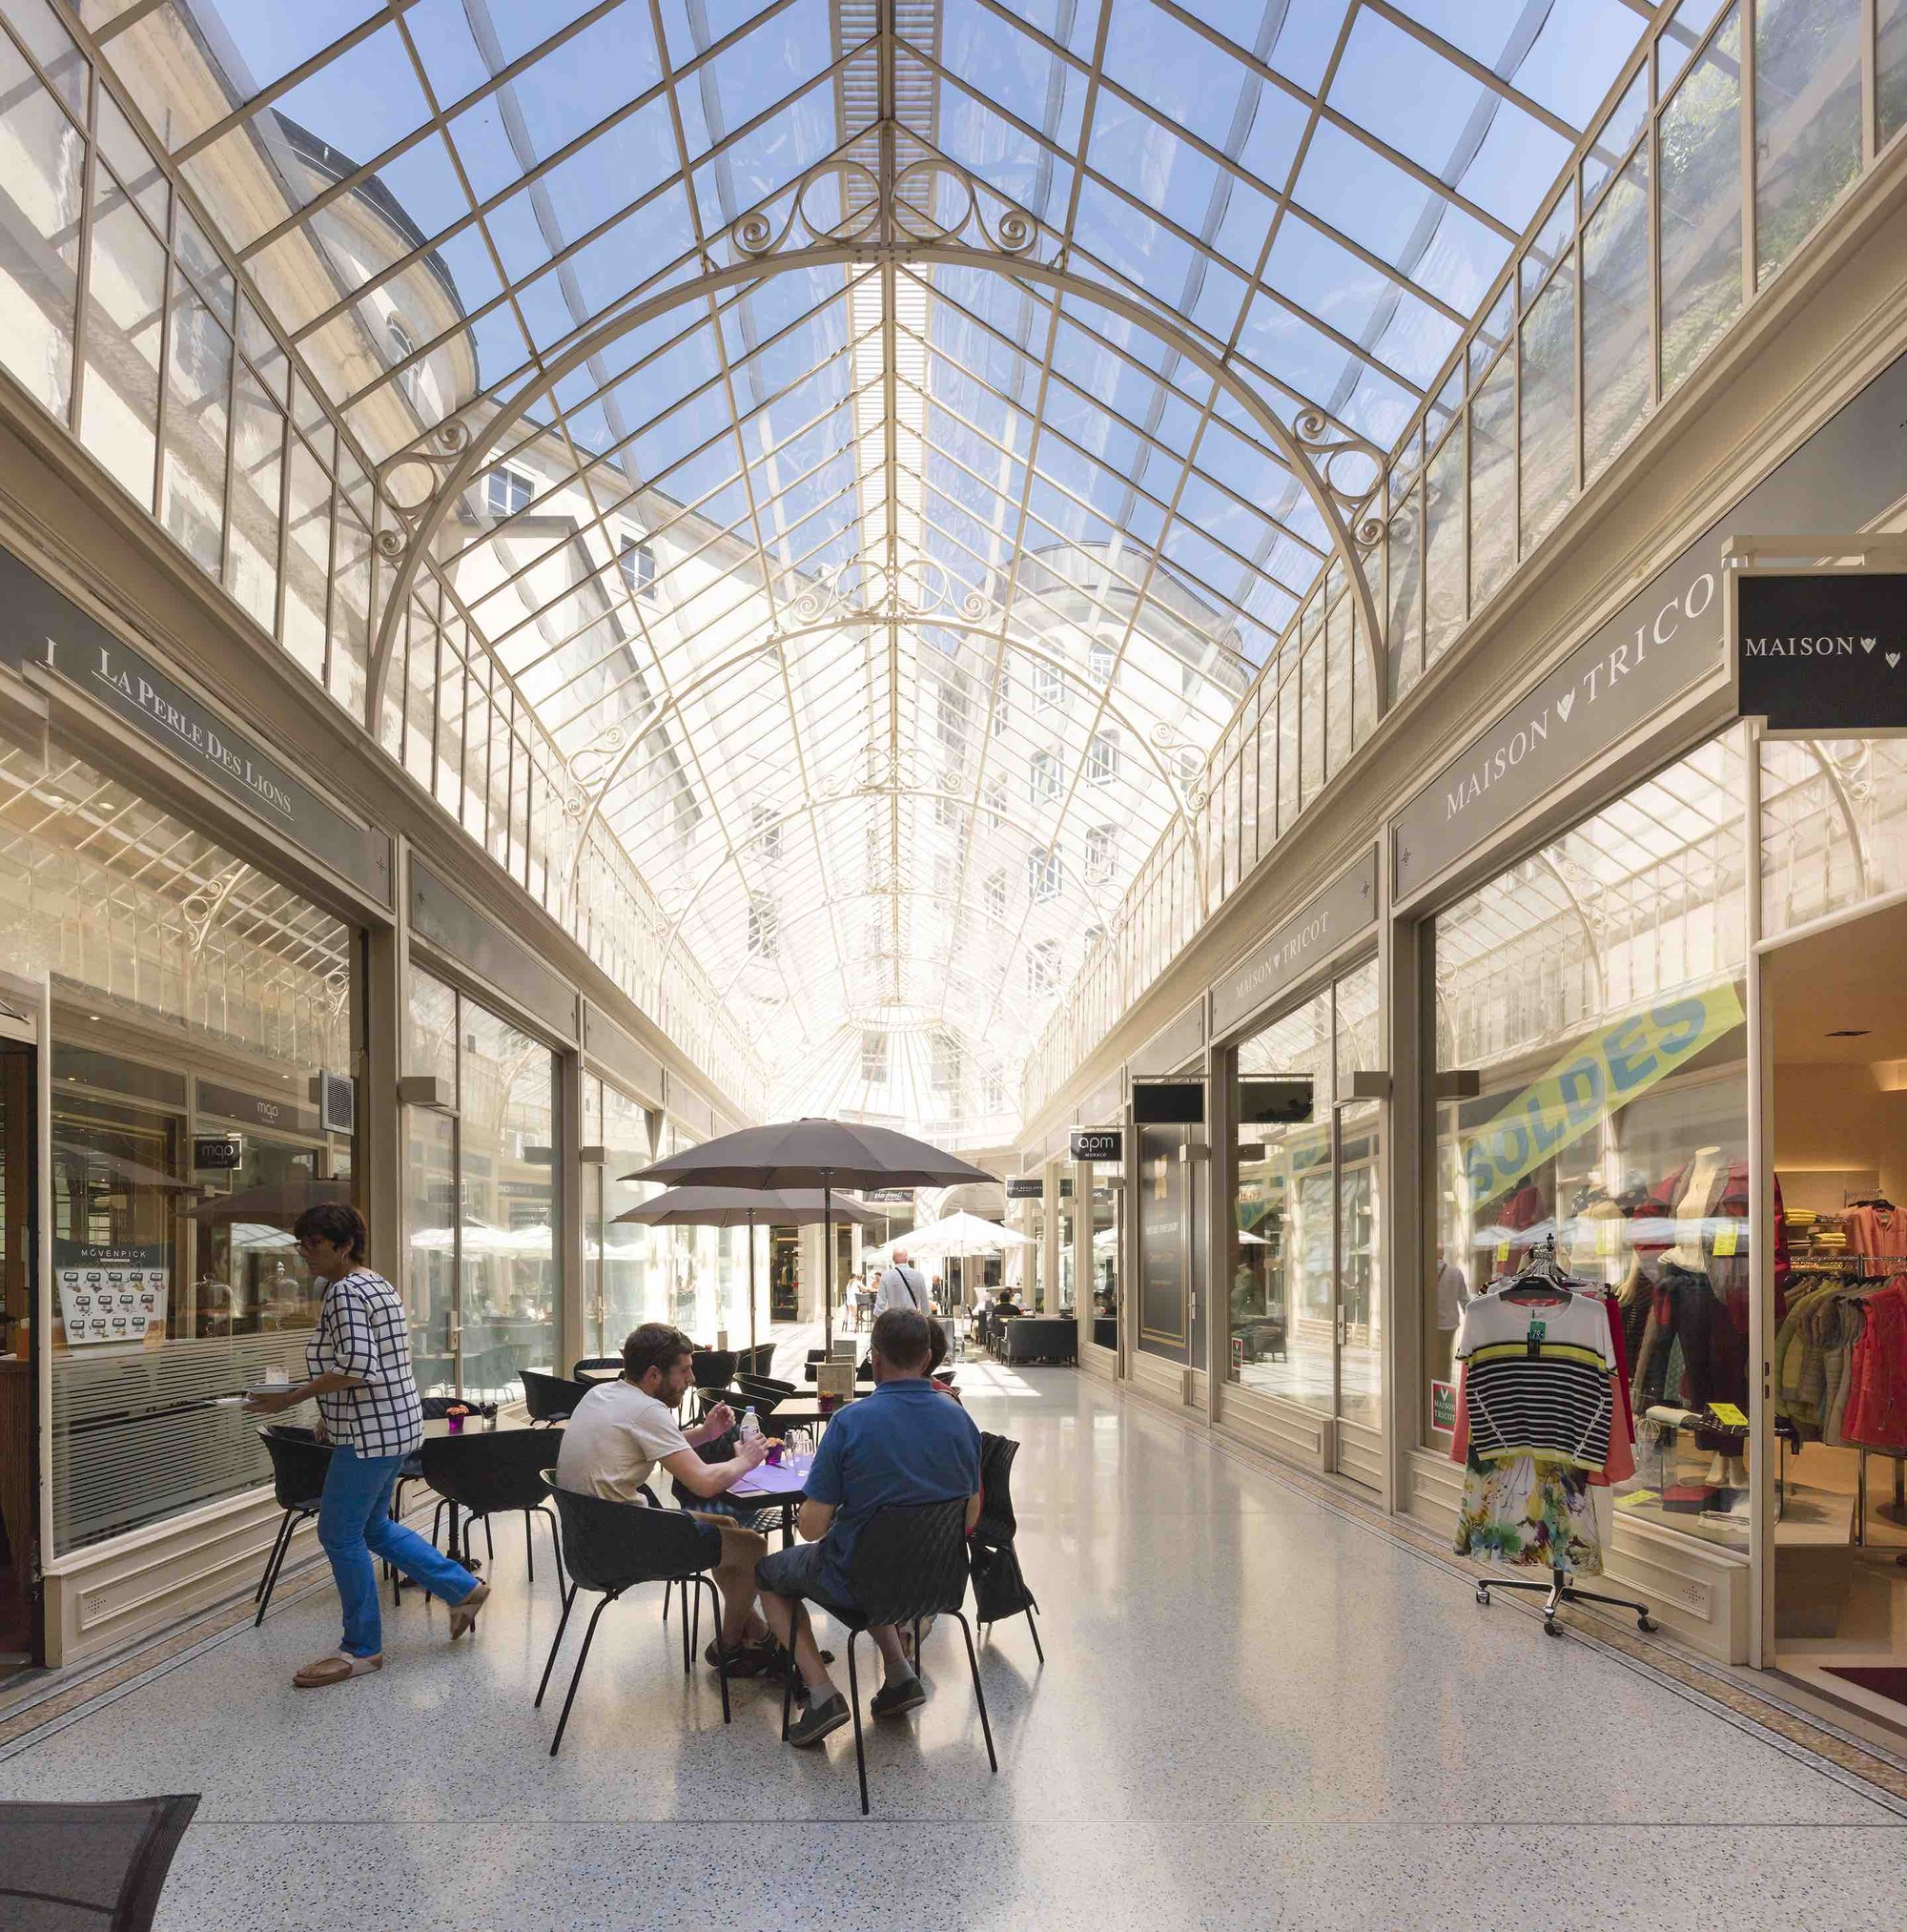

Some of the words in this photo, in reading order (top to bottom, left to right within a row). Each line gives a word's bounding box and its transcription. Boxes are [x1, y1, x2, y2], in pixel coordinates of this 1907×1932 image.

[1446, 708, 1550, 821] MAISON
[1583, 559, 1725, 706] TRICO
[1745, 636, 1855, 657] MAISON
[1236, 957, 1273, 1001] MAISON
[1282, 911, 1329, 965] TRICOT
[1466, 997, 1706, 1201] SOLDES
[1078, 1137, 1114, 1152] apm
